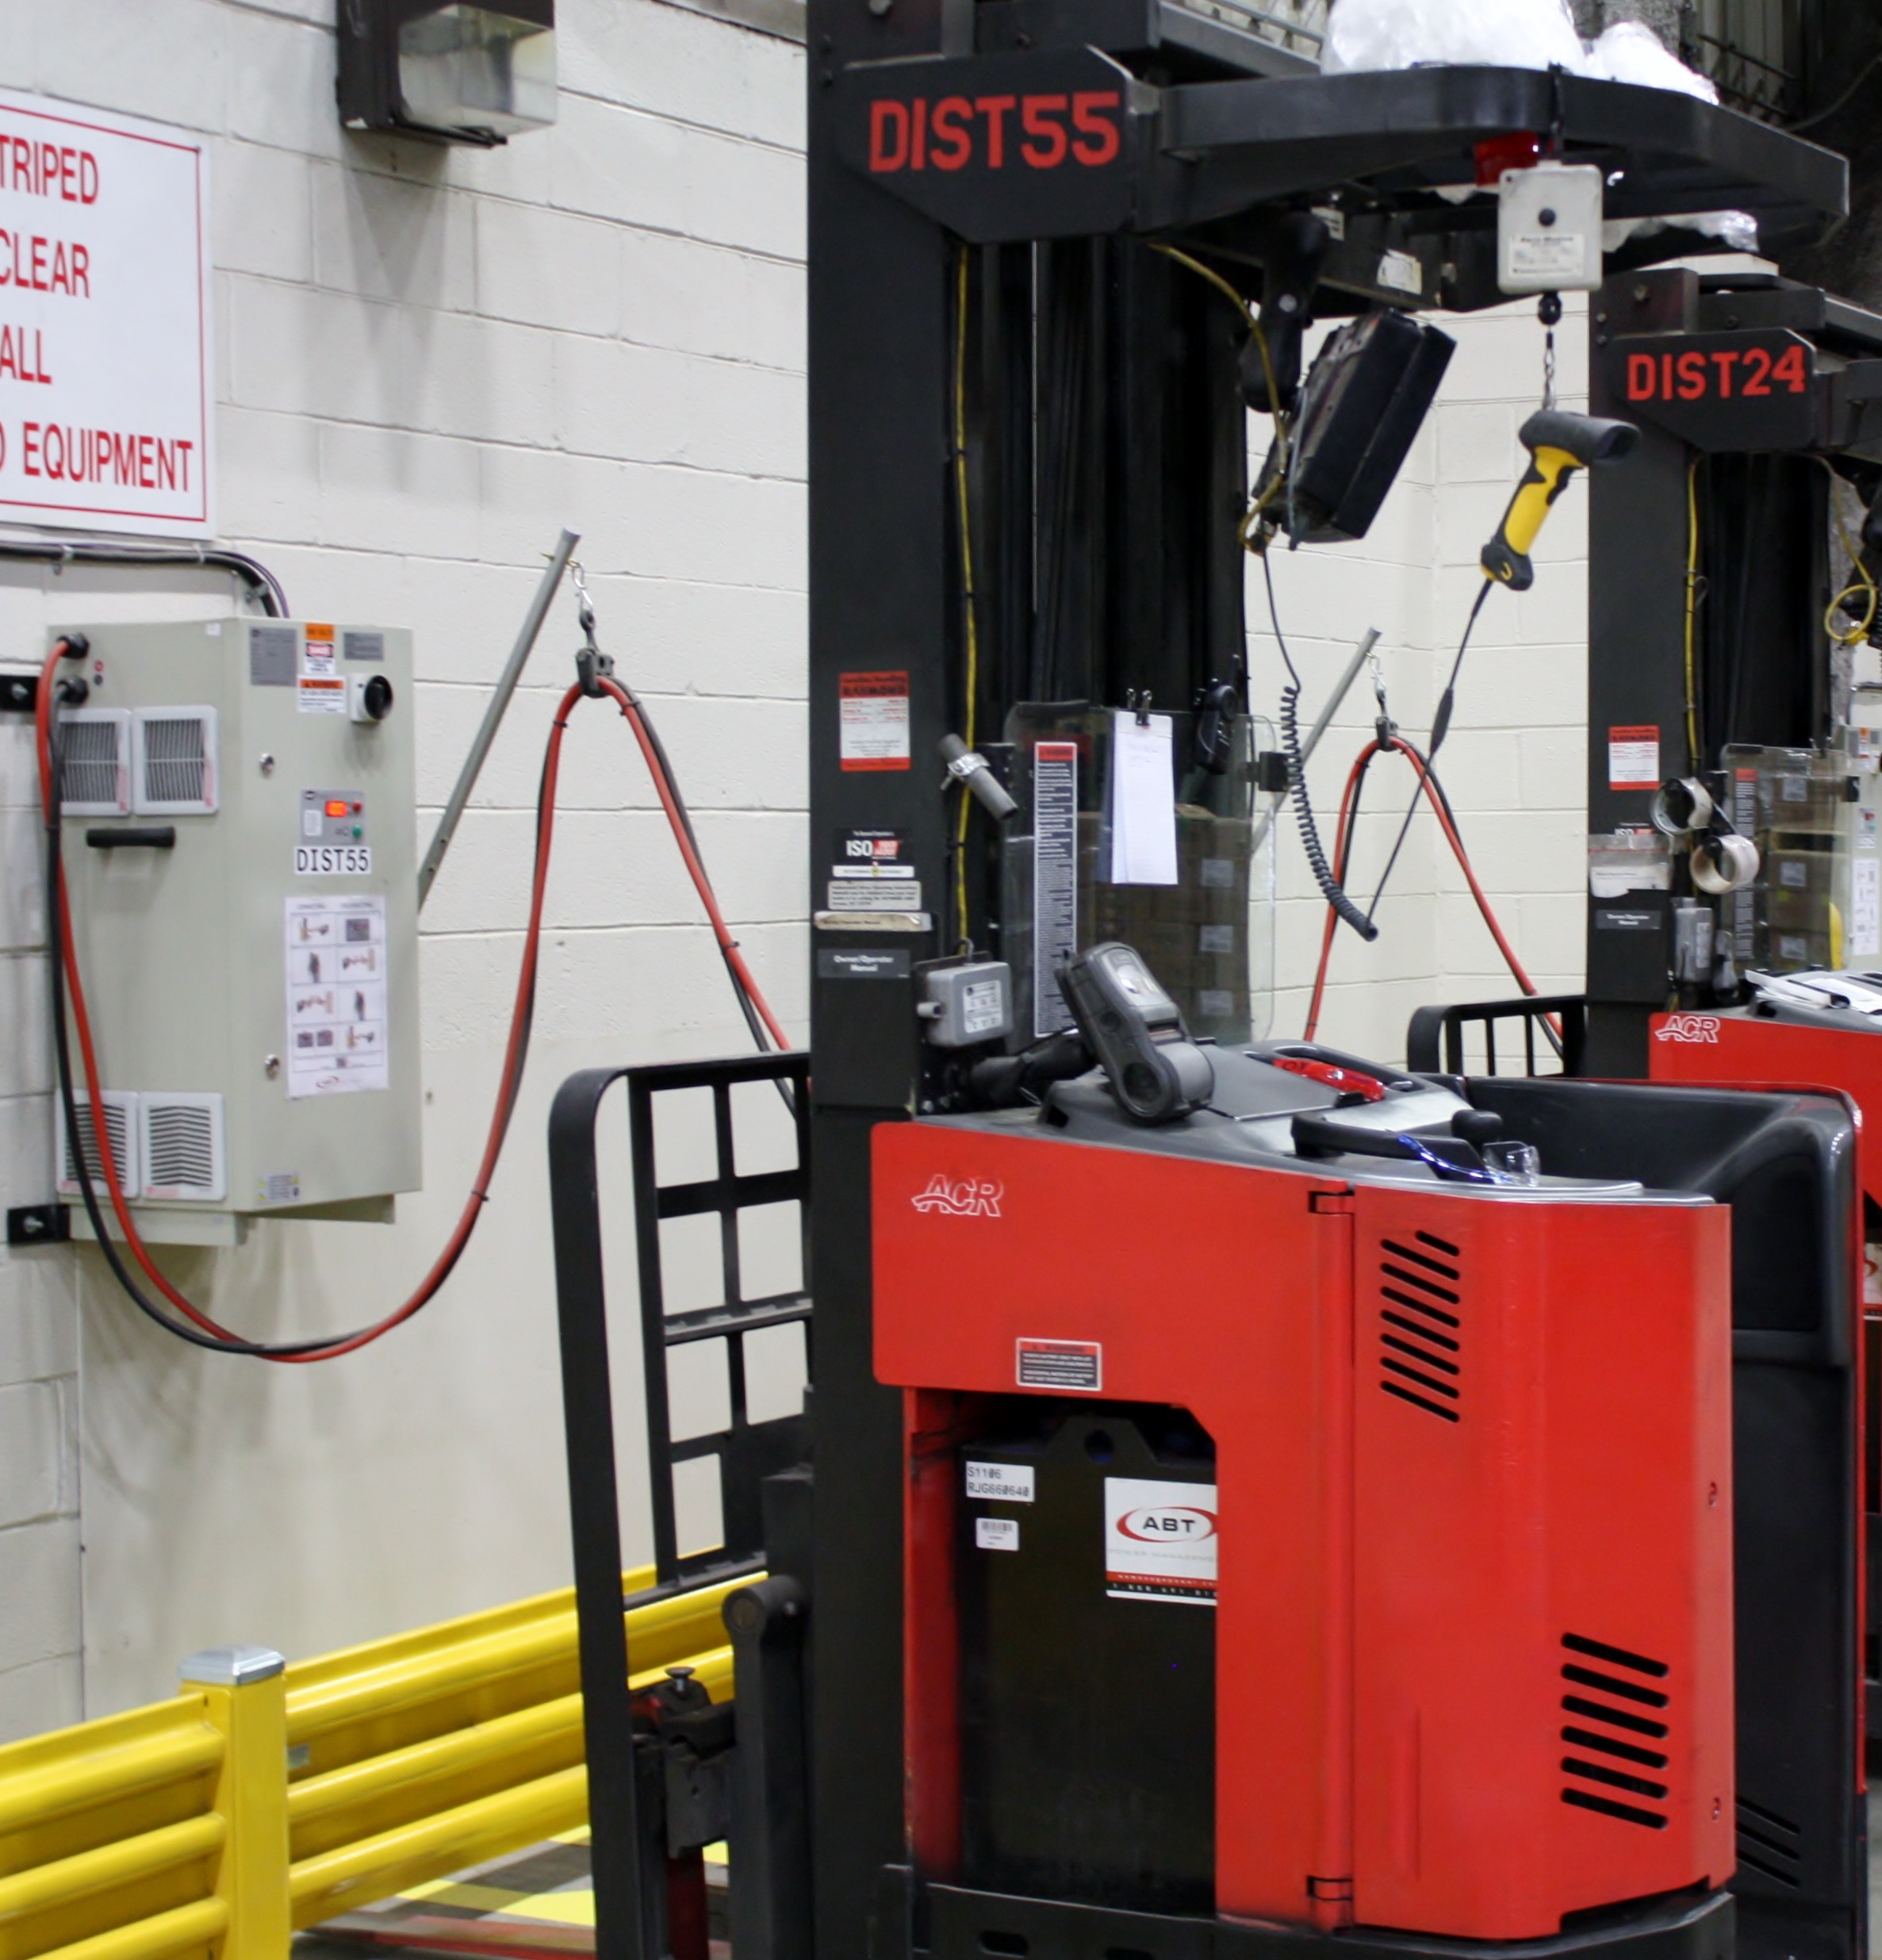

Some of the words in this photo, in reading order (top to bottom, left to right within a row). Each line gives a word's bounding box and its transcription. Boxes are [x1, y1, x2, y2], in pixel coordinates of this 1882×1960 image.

[869, 91, 1120, 171] DIST55
[1627, 345, 1806, 401] DIST24
[23, 422, 193, 492] EQUIPMENT
[297, 849, 368, 872] DIST55
[845, 839, 873, 857] ISO
[1654, 1015, 1720, 1043] ACR
[911, 1174, 1004, 1218] ACR
[1142, 1516, 1196, 1533] ABT
